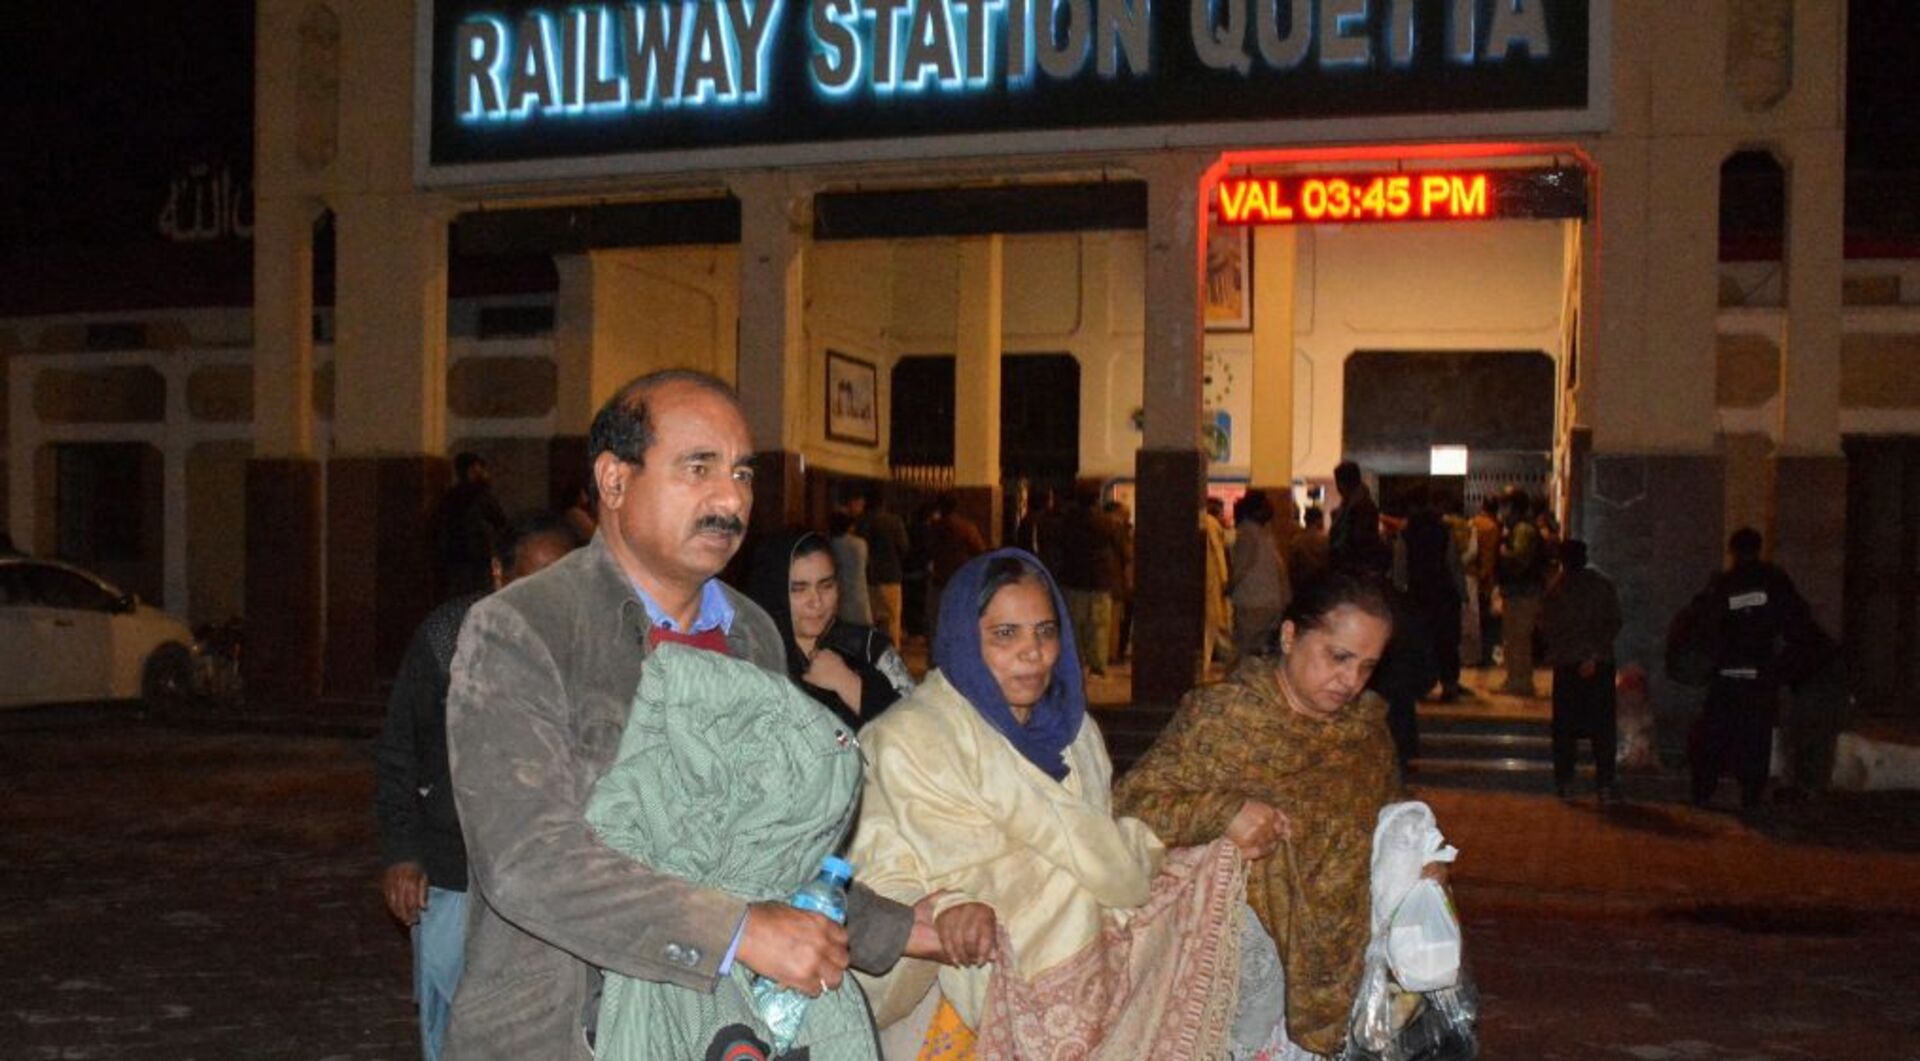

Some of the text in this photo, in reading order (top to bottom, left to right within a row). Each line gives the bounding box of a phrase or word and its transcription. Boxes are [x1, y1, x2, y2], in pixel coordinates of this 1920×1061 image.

[456, 0, 784, 119] RAILWAY
[807, 0, 1151, 91] STATION
[1219, 174, 1487, 221] VAL 03:45 PM
